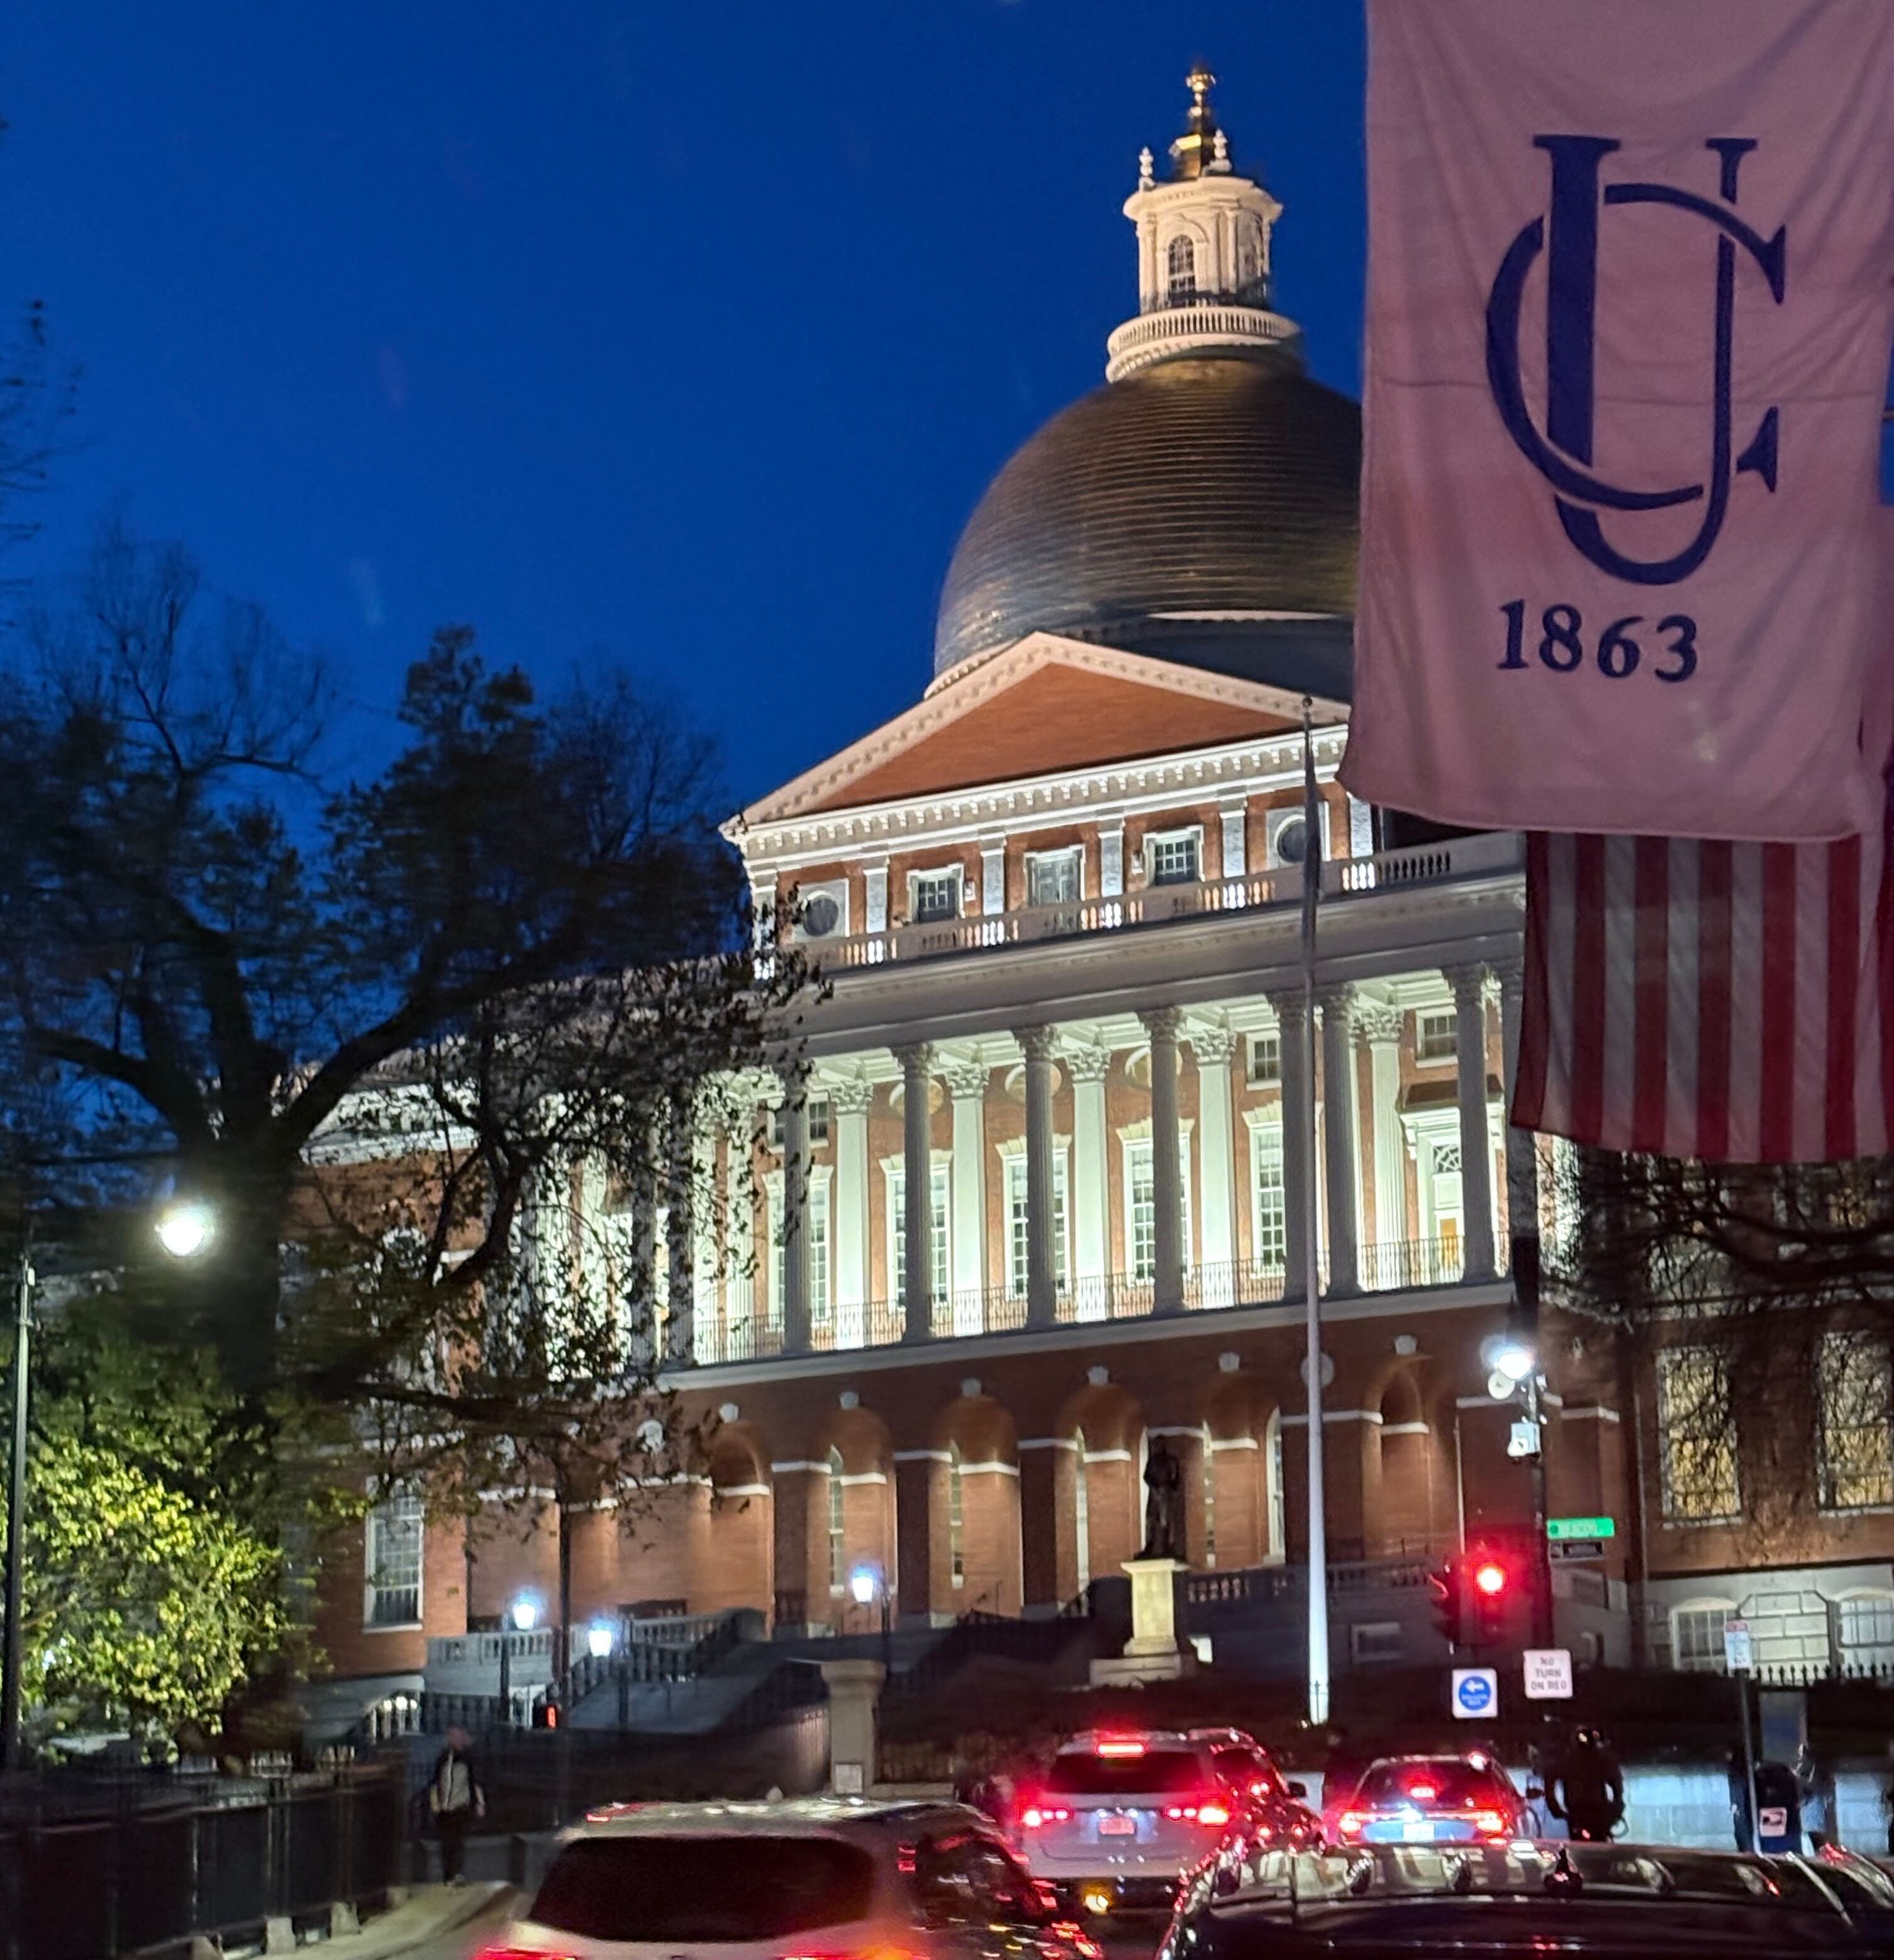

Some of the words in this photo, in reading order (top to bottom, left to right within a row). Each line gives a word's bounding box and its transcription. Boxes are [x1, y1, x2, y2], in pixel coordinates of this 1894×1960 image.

[1497, 599, 1698, 682] 1863
[1540, 1656, 1555, 1666] NO
[1535, 1668, 1562, 1679] TURN
[1530, 1680, 1545, 1691] ON
[1547, 1679, 1568, 1690] RED
